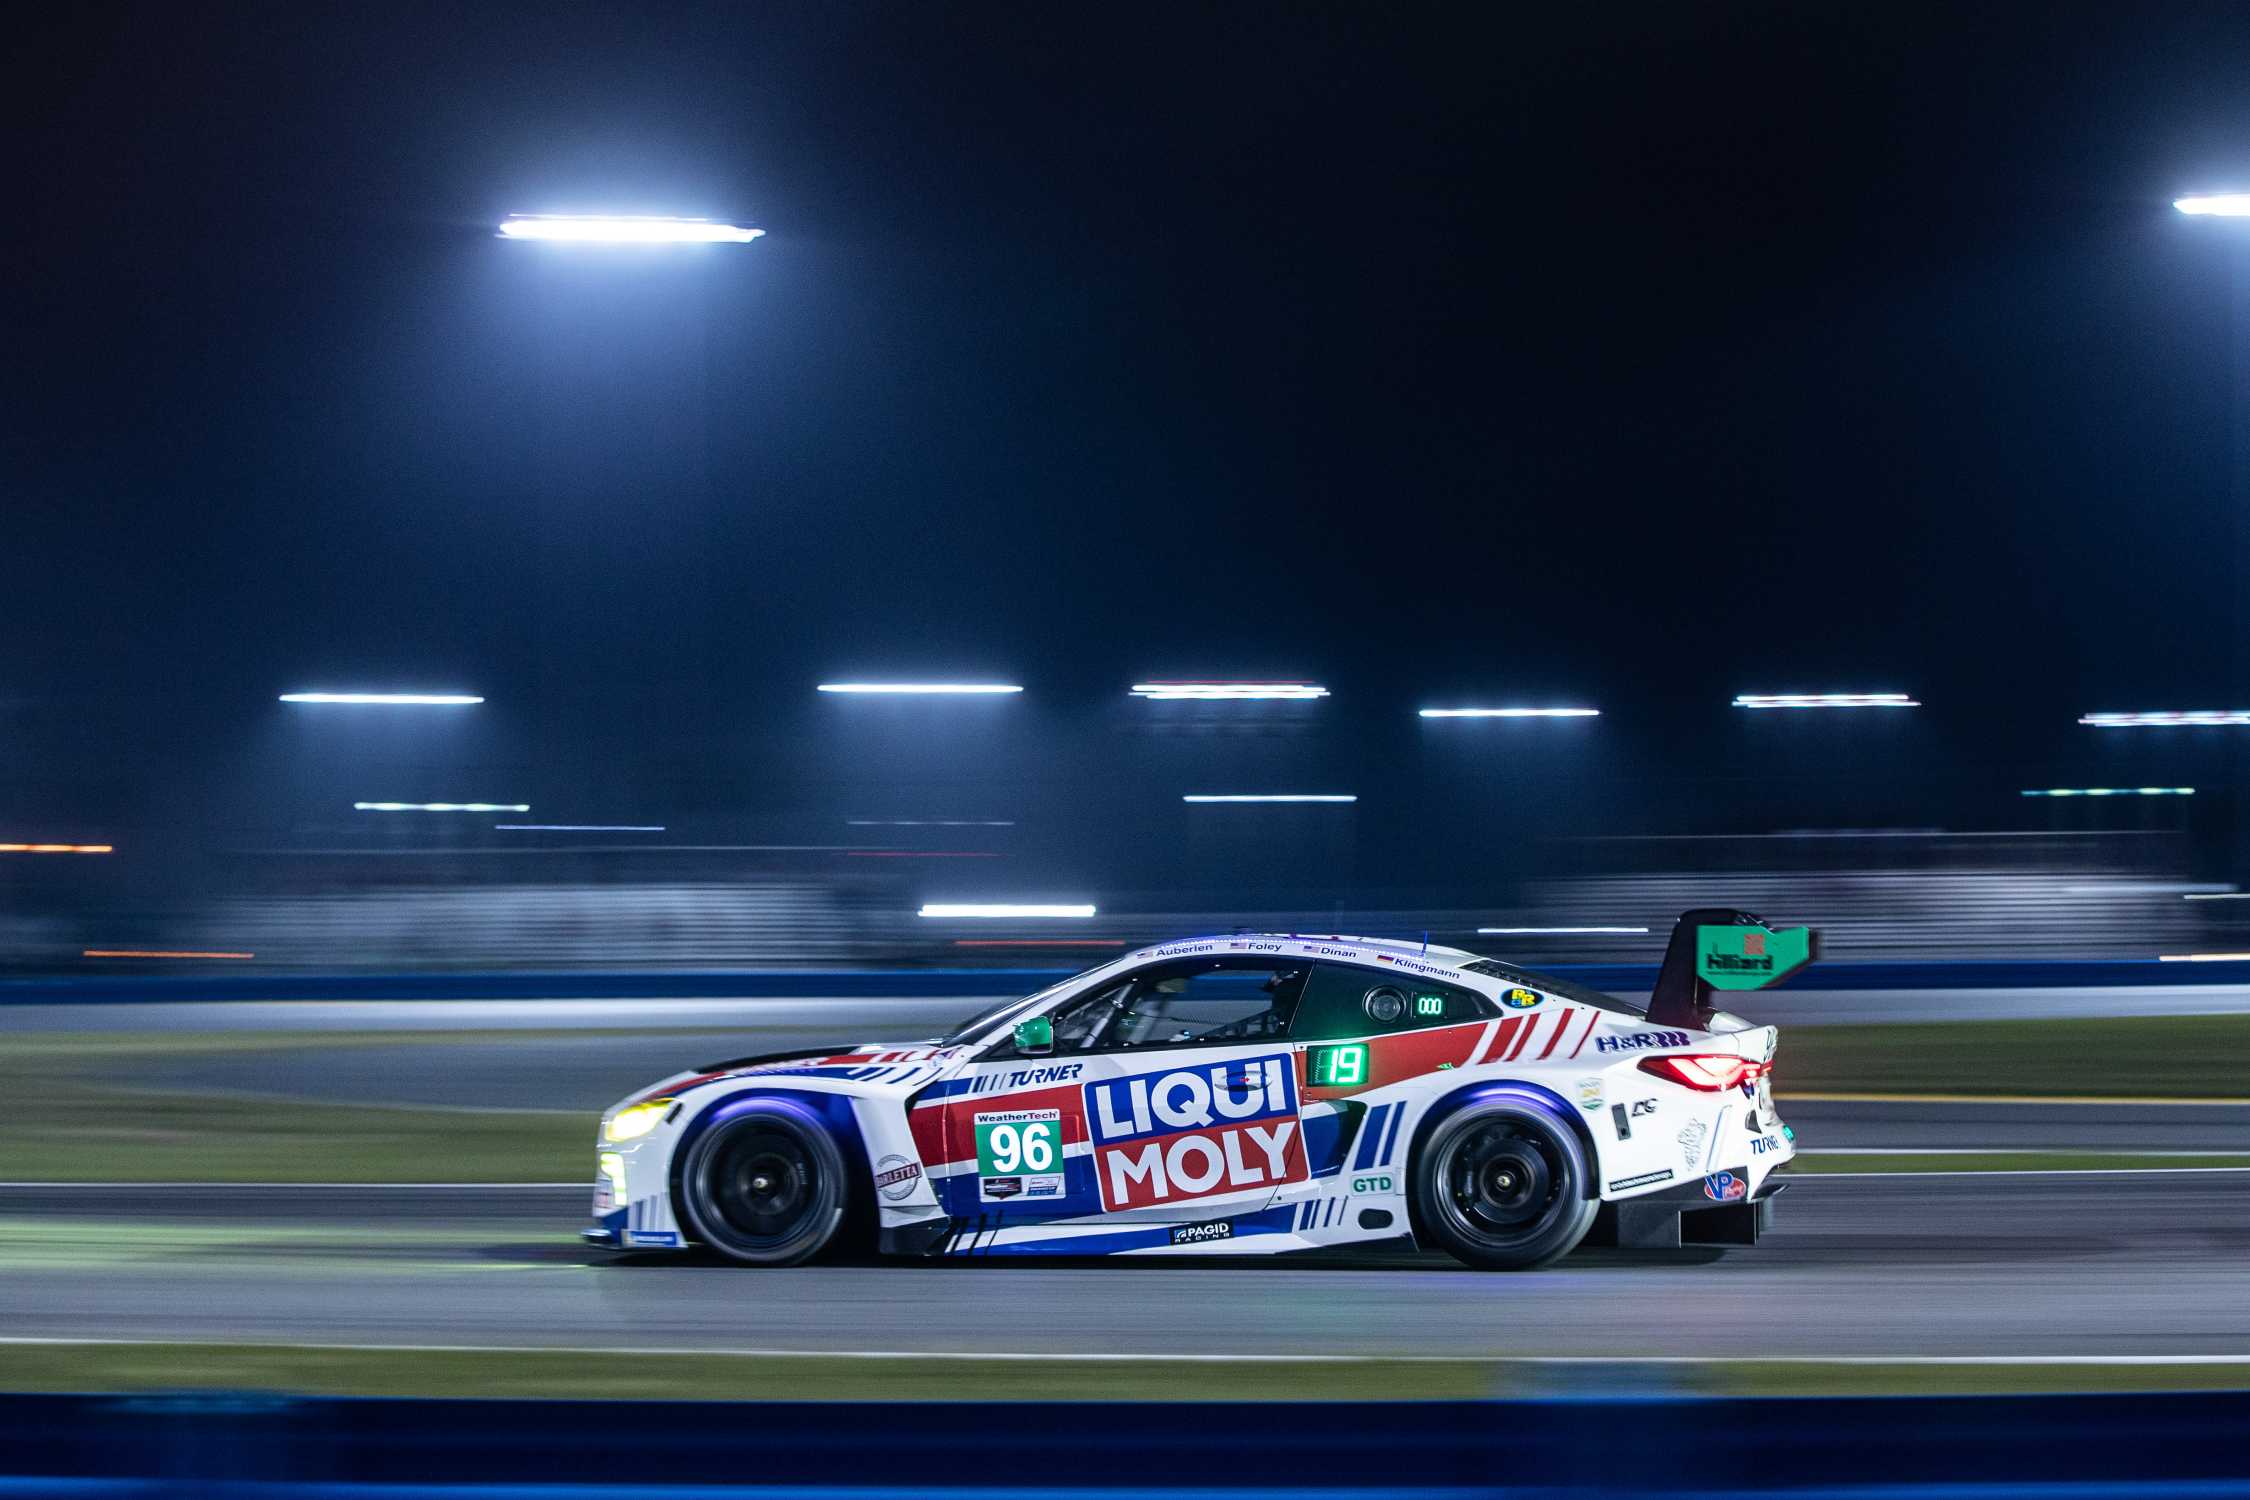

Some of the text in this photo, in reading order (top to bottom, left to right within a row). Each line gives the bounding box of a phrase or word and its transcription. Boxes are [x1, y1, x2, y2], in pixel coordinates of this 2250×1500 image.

[1156, 942, 1461, 979] Auberlen Foley Dinan Klingmann
[1009, 1063, 1084, 1088] TURNER
[1329, 1047, 1363, 1082] 19
[1095, 1059, 1287, 1139] LIQUI
[977, 1111, 1057, 1123] WeatherTech
[990, 1122, 1053, 1173] 96
[1106, 1121, 1297, 1206] MOLY
[1353, 1176, 1392, 1193] GTD
[1187, 1222, 1229, 1238] PAGID
